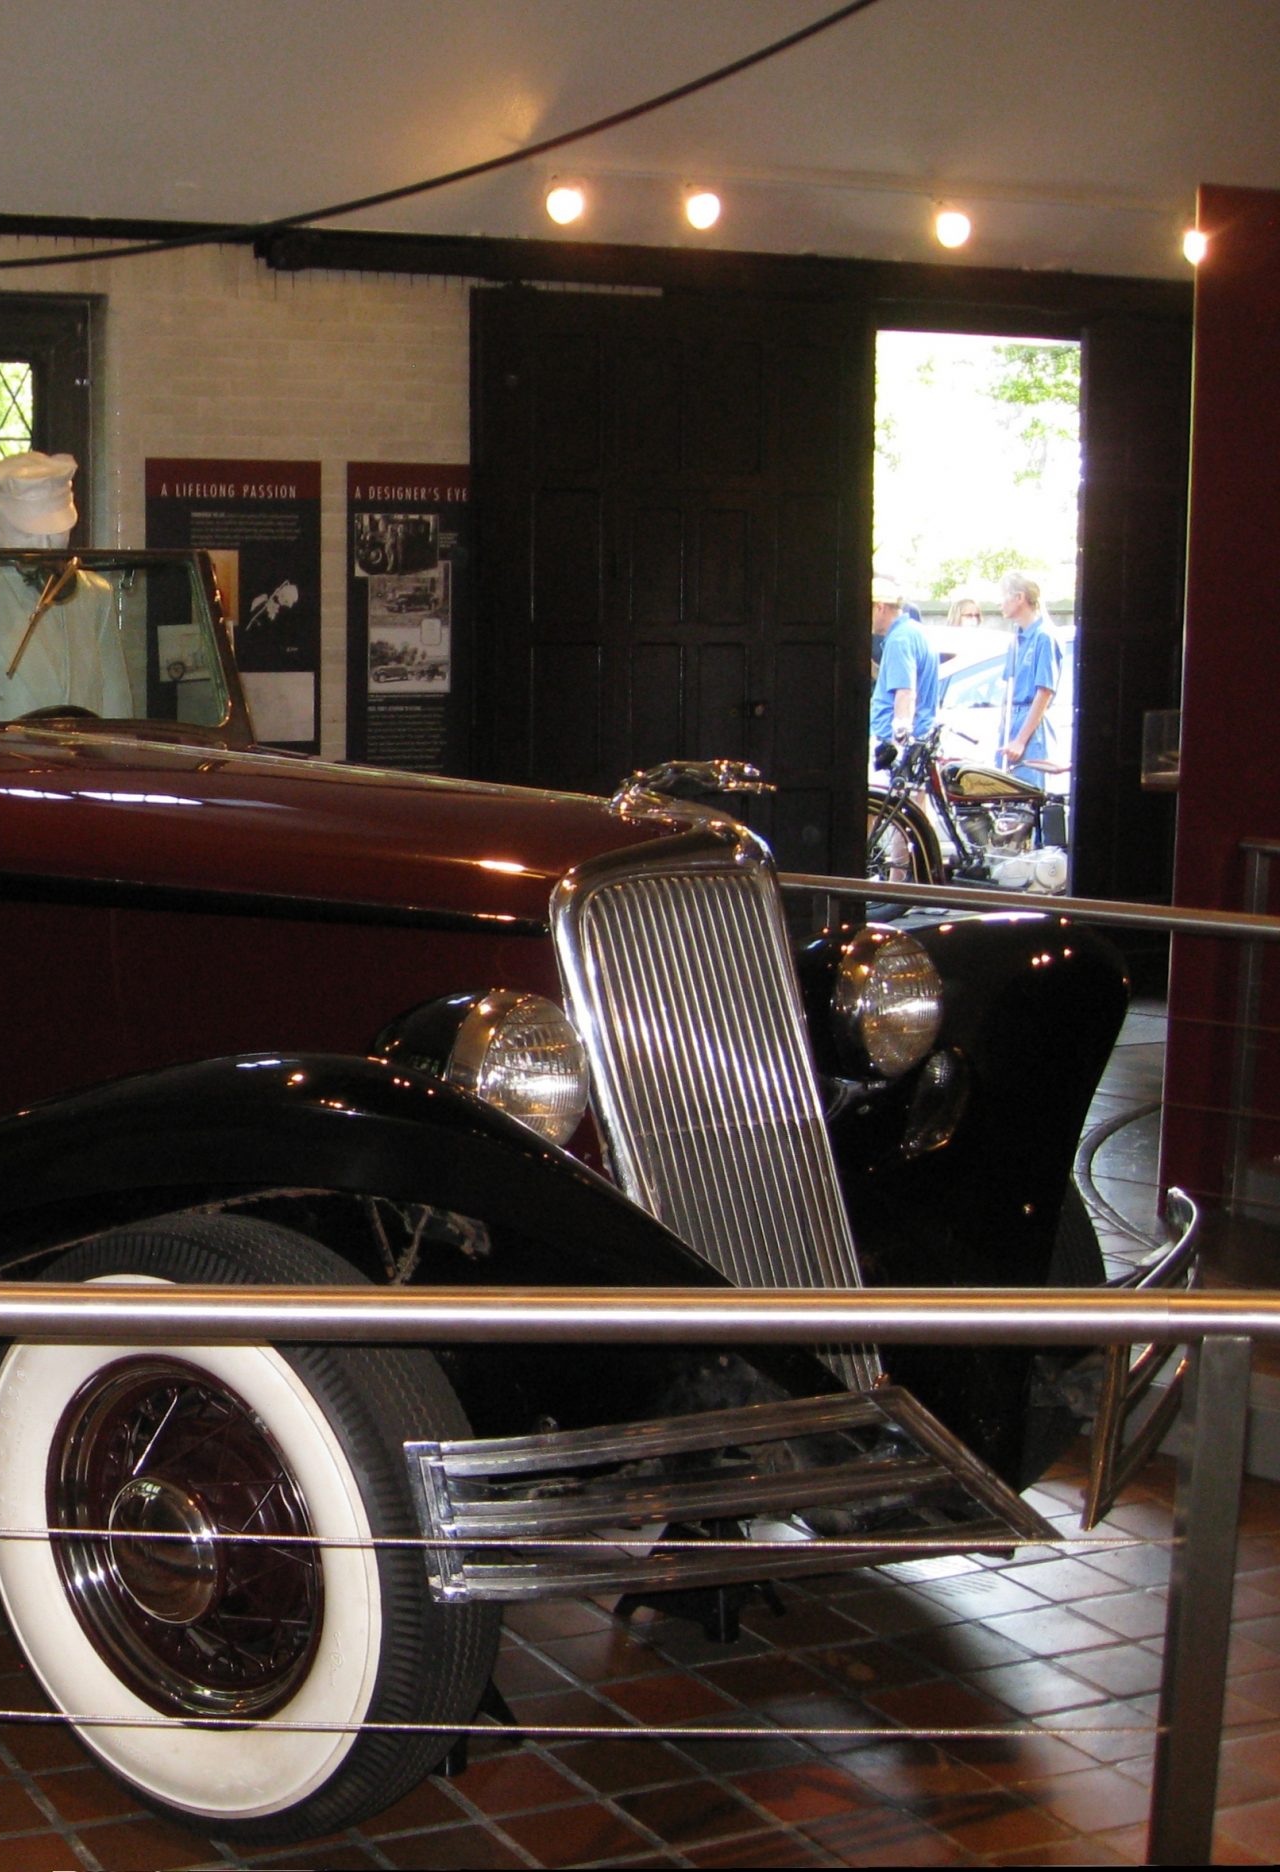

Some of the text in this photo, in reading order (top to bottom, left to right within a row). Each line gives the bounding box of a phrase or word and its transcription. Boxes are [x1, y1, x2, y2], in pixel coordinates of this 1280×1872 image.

[160, 483, 296, 499] A LIFELONG PASSION
[354, 486, 468, 502] A DESIGNER'S EYE
